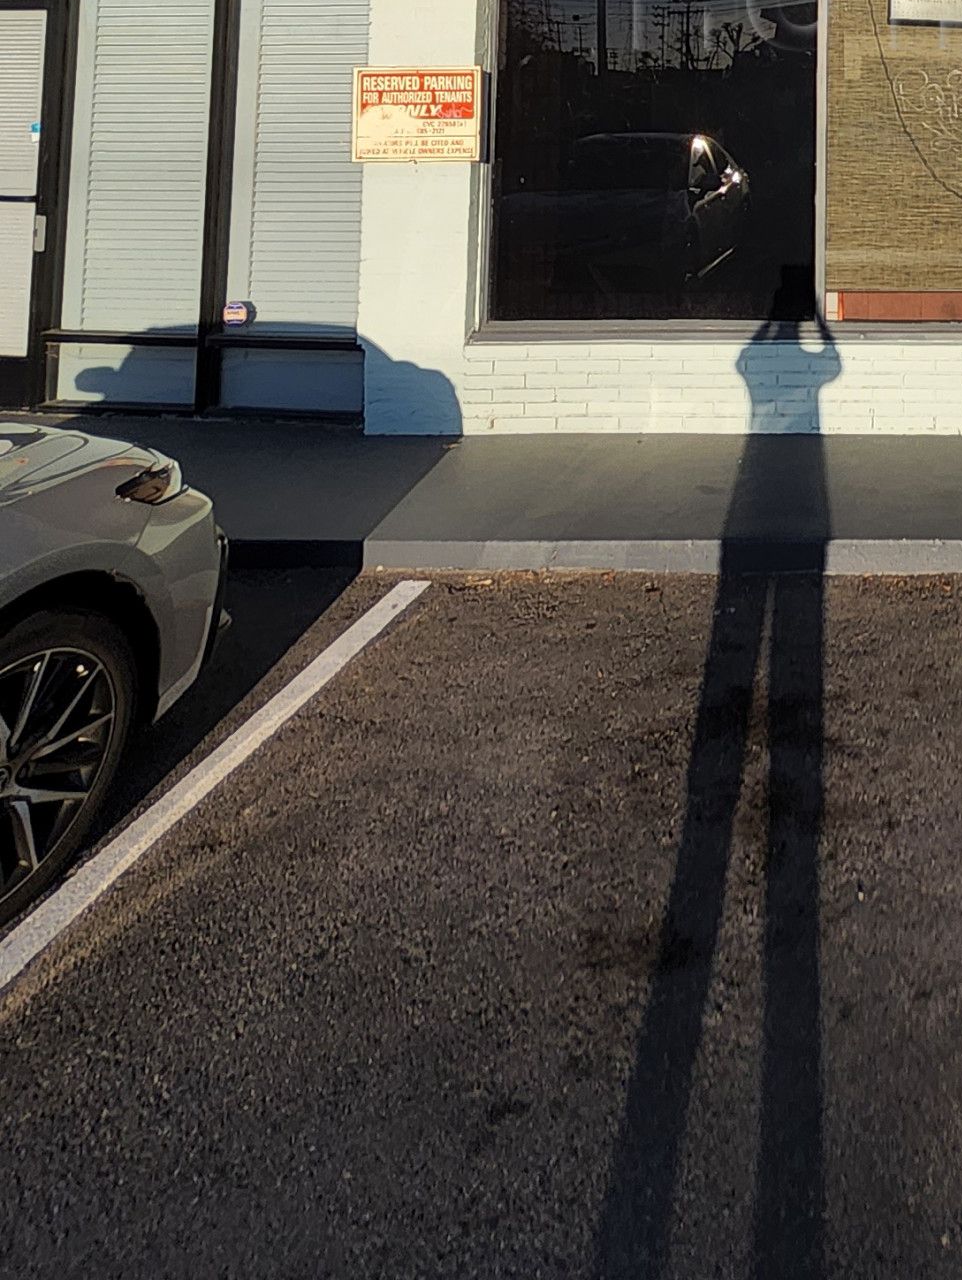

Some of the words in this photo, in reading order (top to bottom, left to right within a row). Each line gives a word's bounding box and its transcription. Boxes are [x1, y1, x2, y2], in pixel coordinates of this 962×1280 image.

[363, 76, 419, 91] RESERVED
[424, 76, 472, 90] PARKING
[363, 92, 379, 104] FOR
[381, 92, 432, 104] AUTHORIZED
[436, 91, 472, 103] TENANTS
